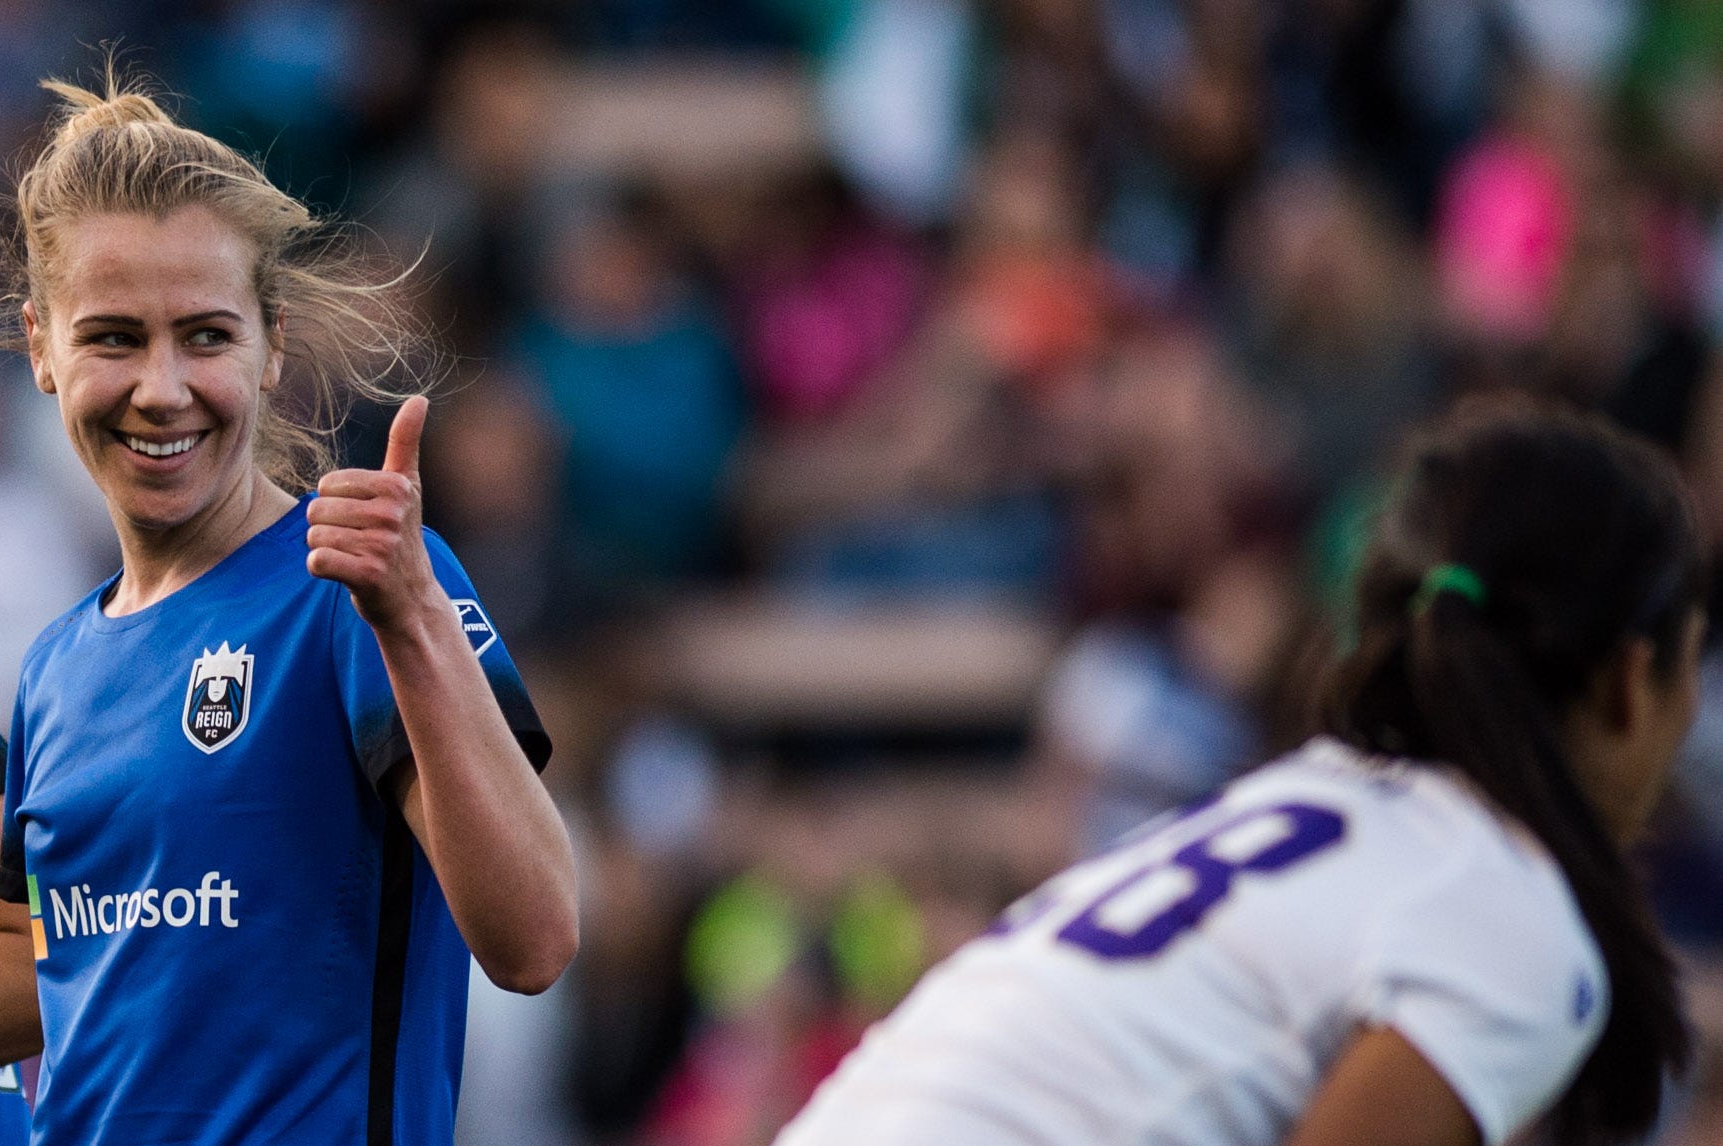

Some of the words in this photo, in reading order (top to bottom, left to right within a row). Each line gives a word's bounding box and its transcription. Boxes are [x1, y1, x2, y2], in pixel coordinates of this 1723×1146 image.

[463, 622, 489, 632] NWSL
[195, 711, 233, 729] REIGN
[205, 729, 218, 738] FC
[49, 871, 239, 940] Microsoft
